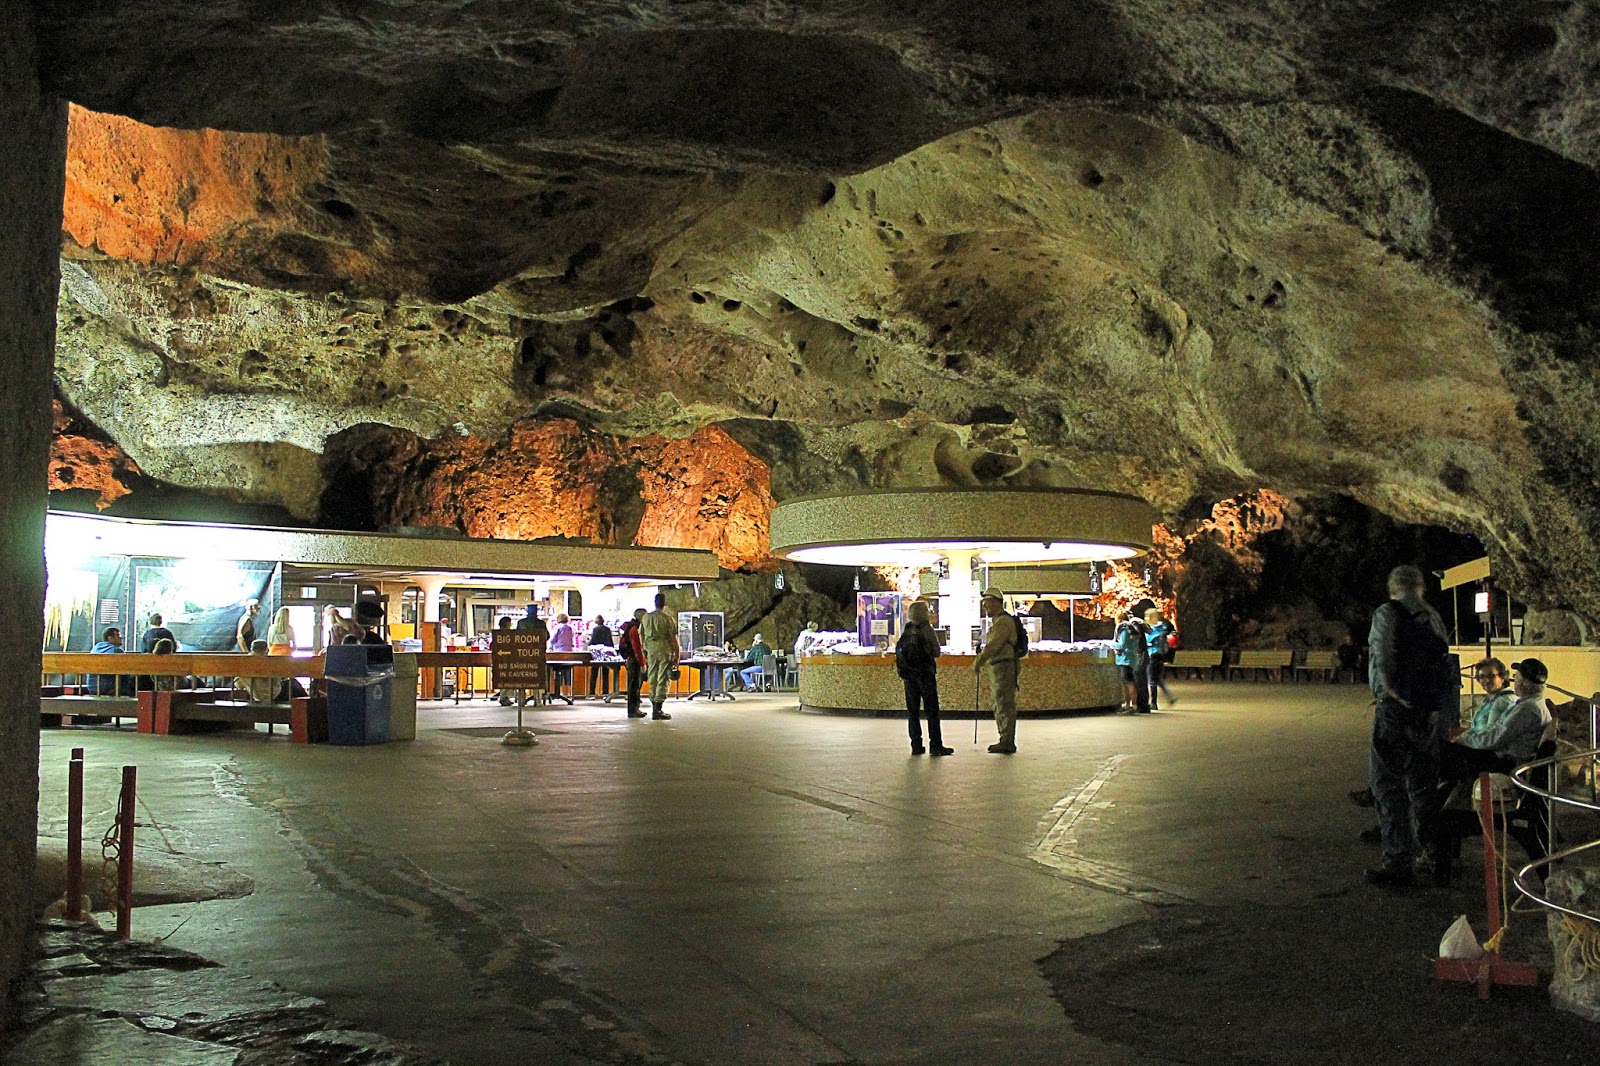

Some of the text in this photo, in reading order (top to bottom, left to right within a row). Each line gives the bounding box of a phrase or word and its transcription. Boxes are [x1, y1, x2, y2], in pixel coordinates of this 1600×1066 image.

[496, 635, 540, 643] BIG ROOM
[517, 648, 540, 657] TOUR
